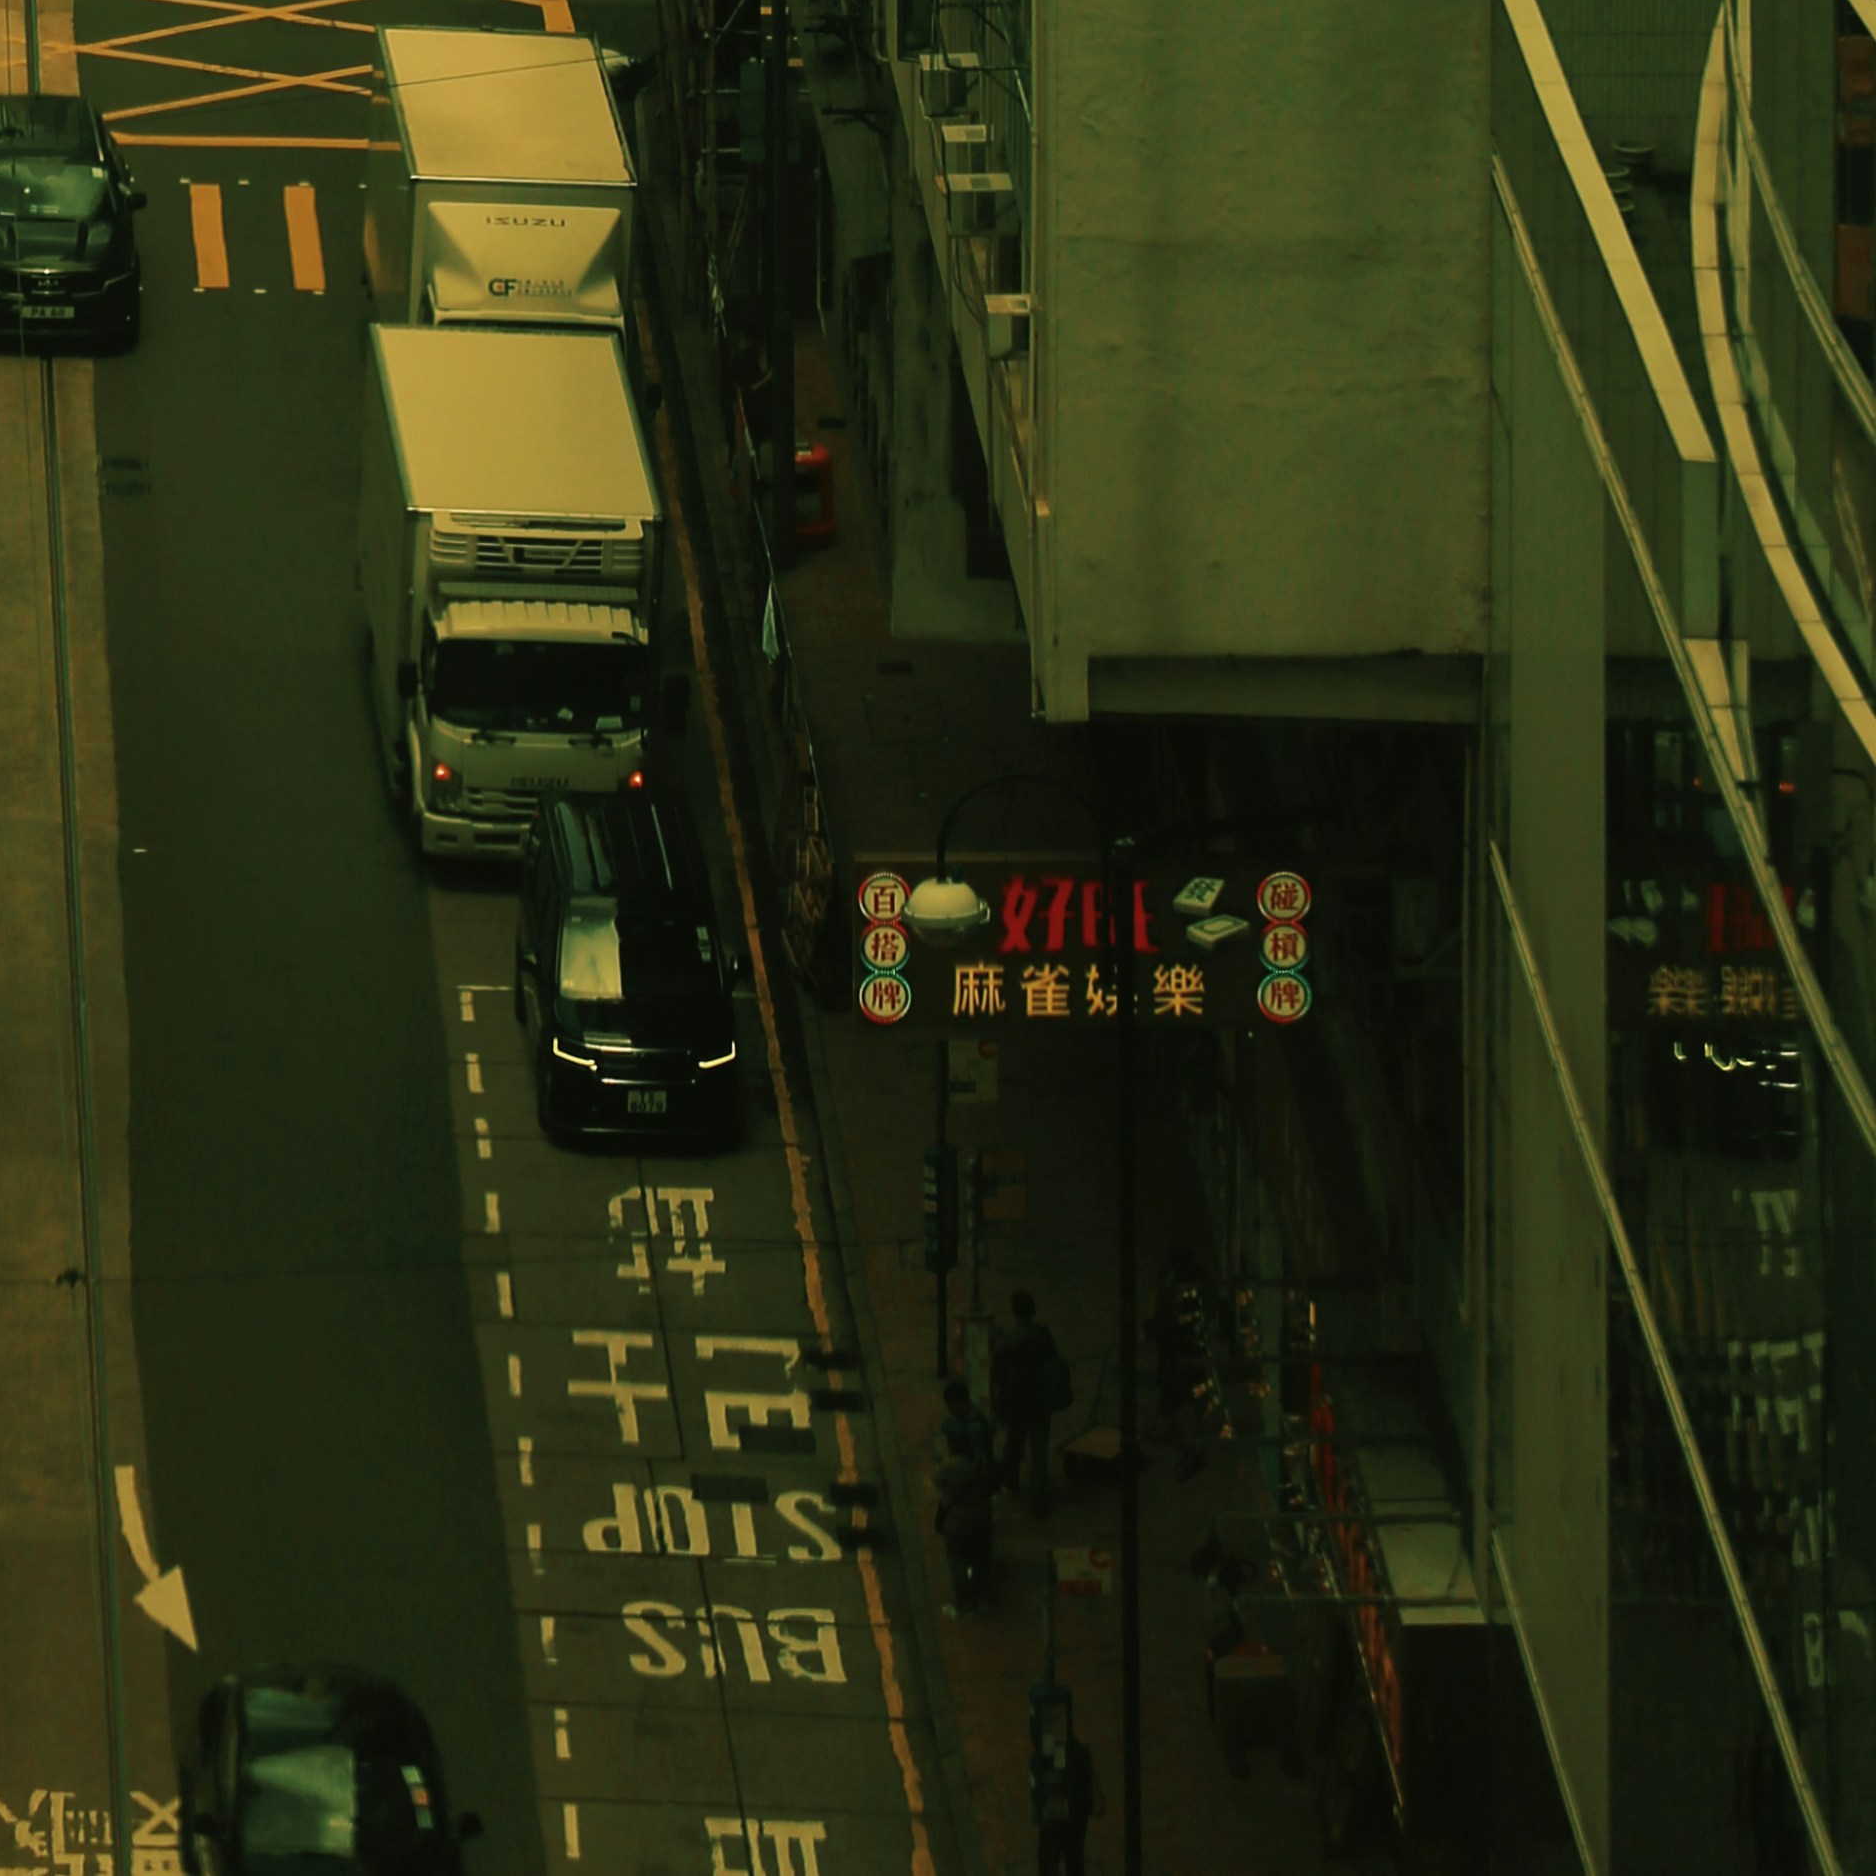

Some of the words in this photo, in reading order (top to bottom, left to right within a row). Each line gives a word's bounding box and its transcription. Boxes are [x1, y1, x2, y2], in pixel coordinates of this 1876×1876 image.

[485, 217, 566, 227] ISUZU
[870, 882, 903, 1012] 百搭牌
[566, 1329, 814, 1452] 巴士
[583, 1482, 843, 1563] STOP
[621, 1601, 847, 1684] BUS
